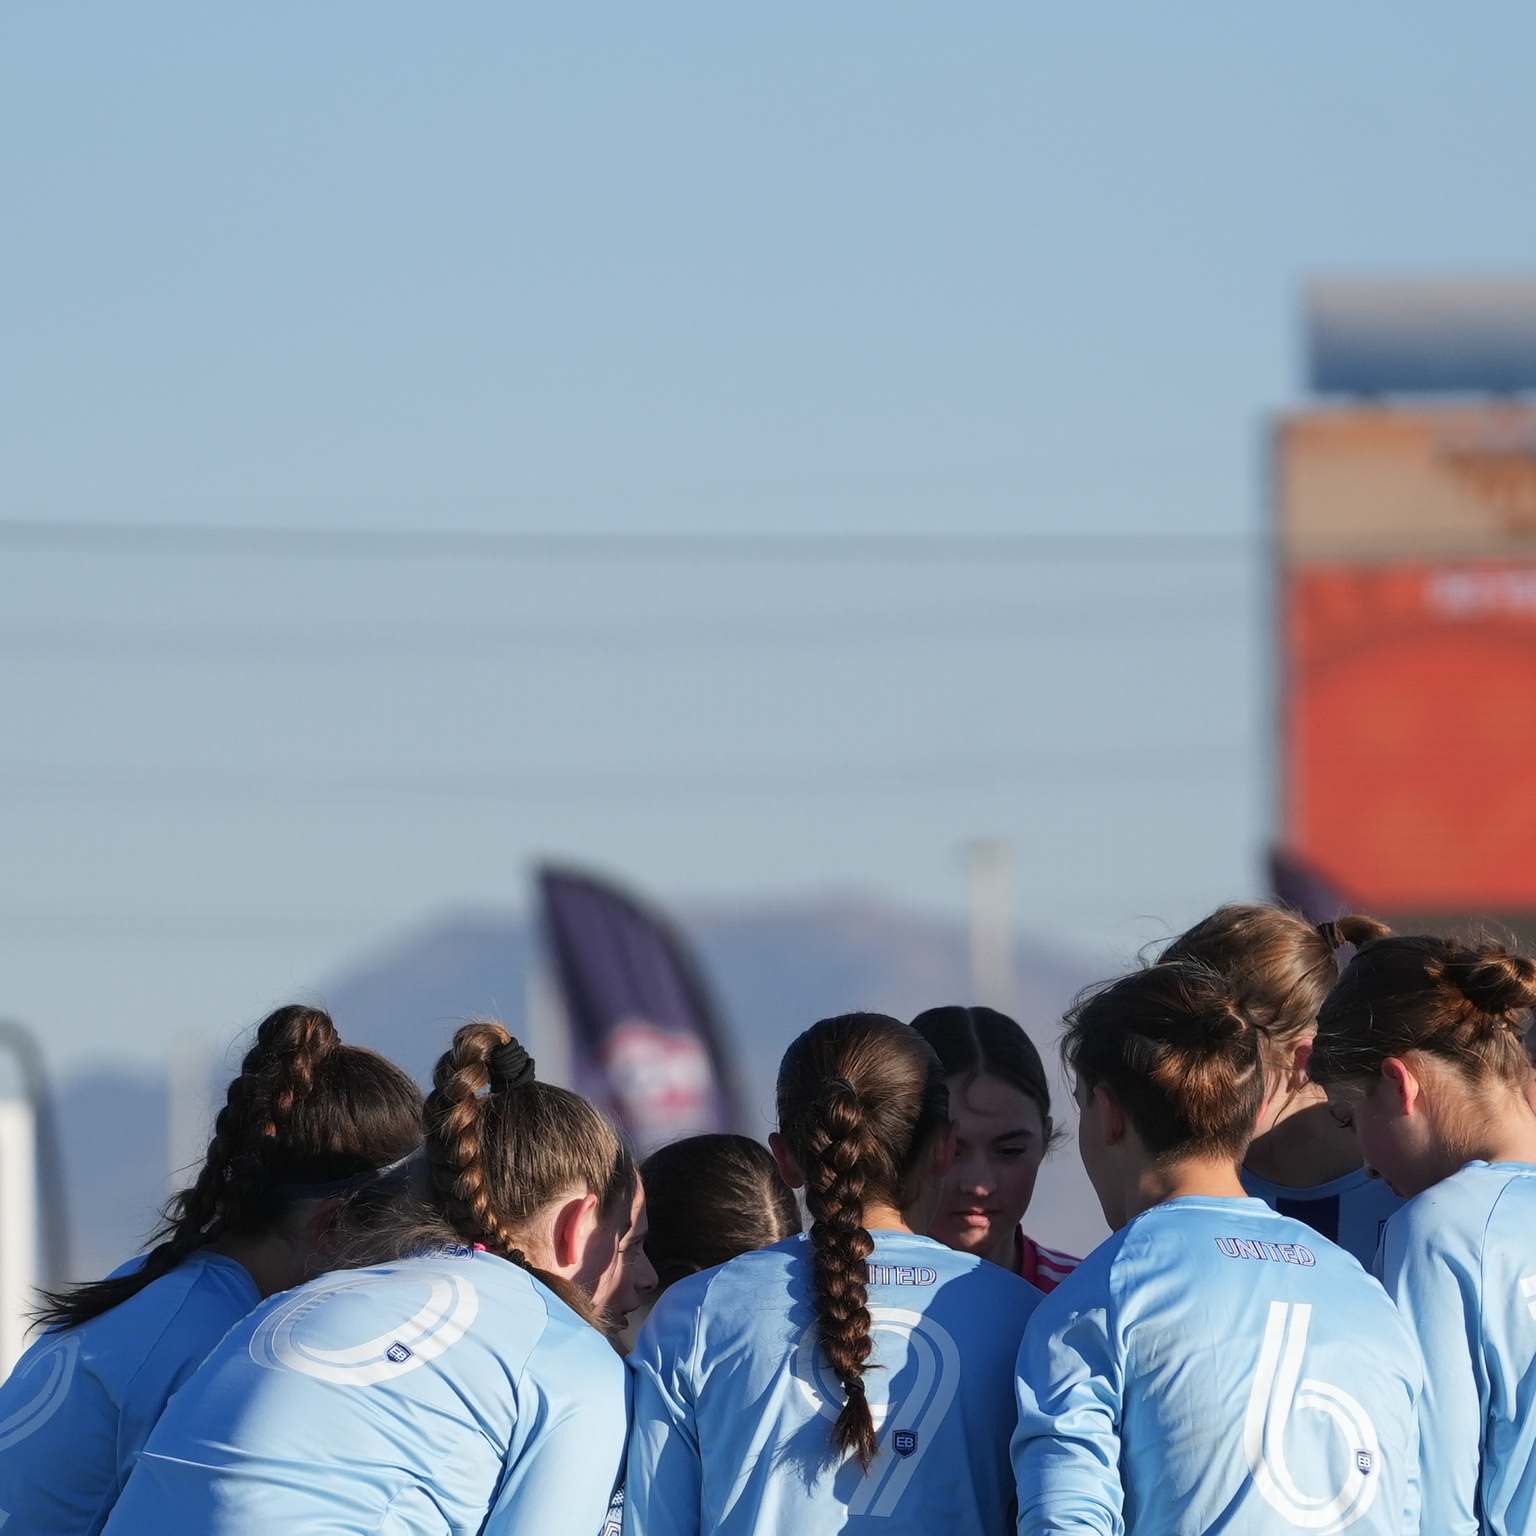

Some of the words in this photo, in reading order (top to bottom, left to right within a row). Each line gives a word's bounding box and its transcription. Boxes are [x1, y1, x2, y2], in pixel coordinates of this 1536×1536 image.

[1215, 1238, 1316, 1267] UNITED
[868, 1265, 937, 1286] ITED
[797, 1307, 961, 1518] 9
[1244, 1301, 1381, 1535] 6
[896, 1436, 914, 1448] EB
[1357, 1455, 1371, 1468] EB
